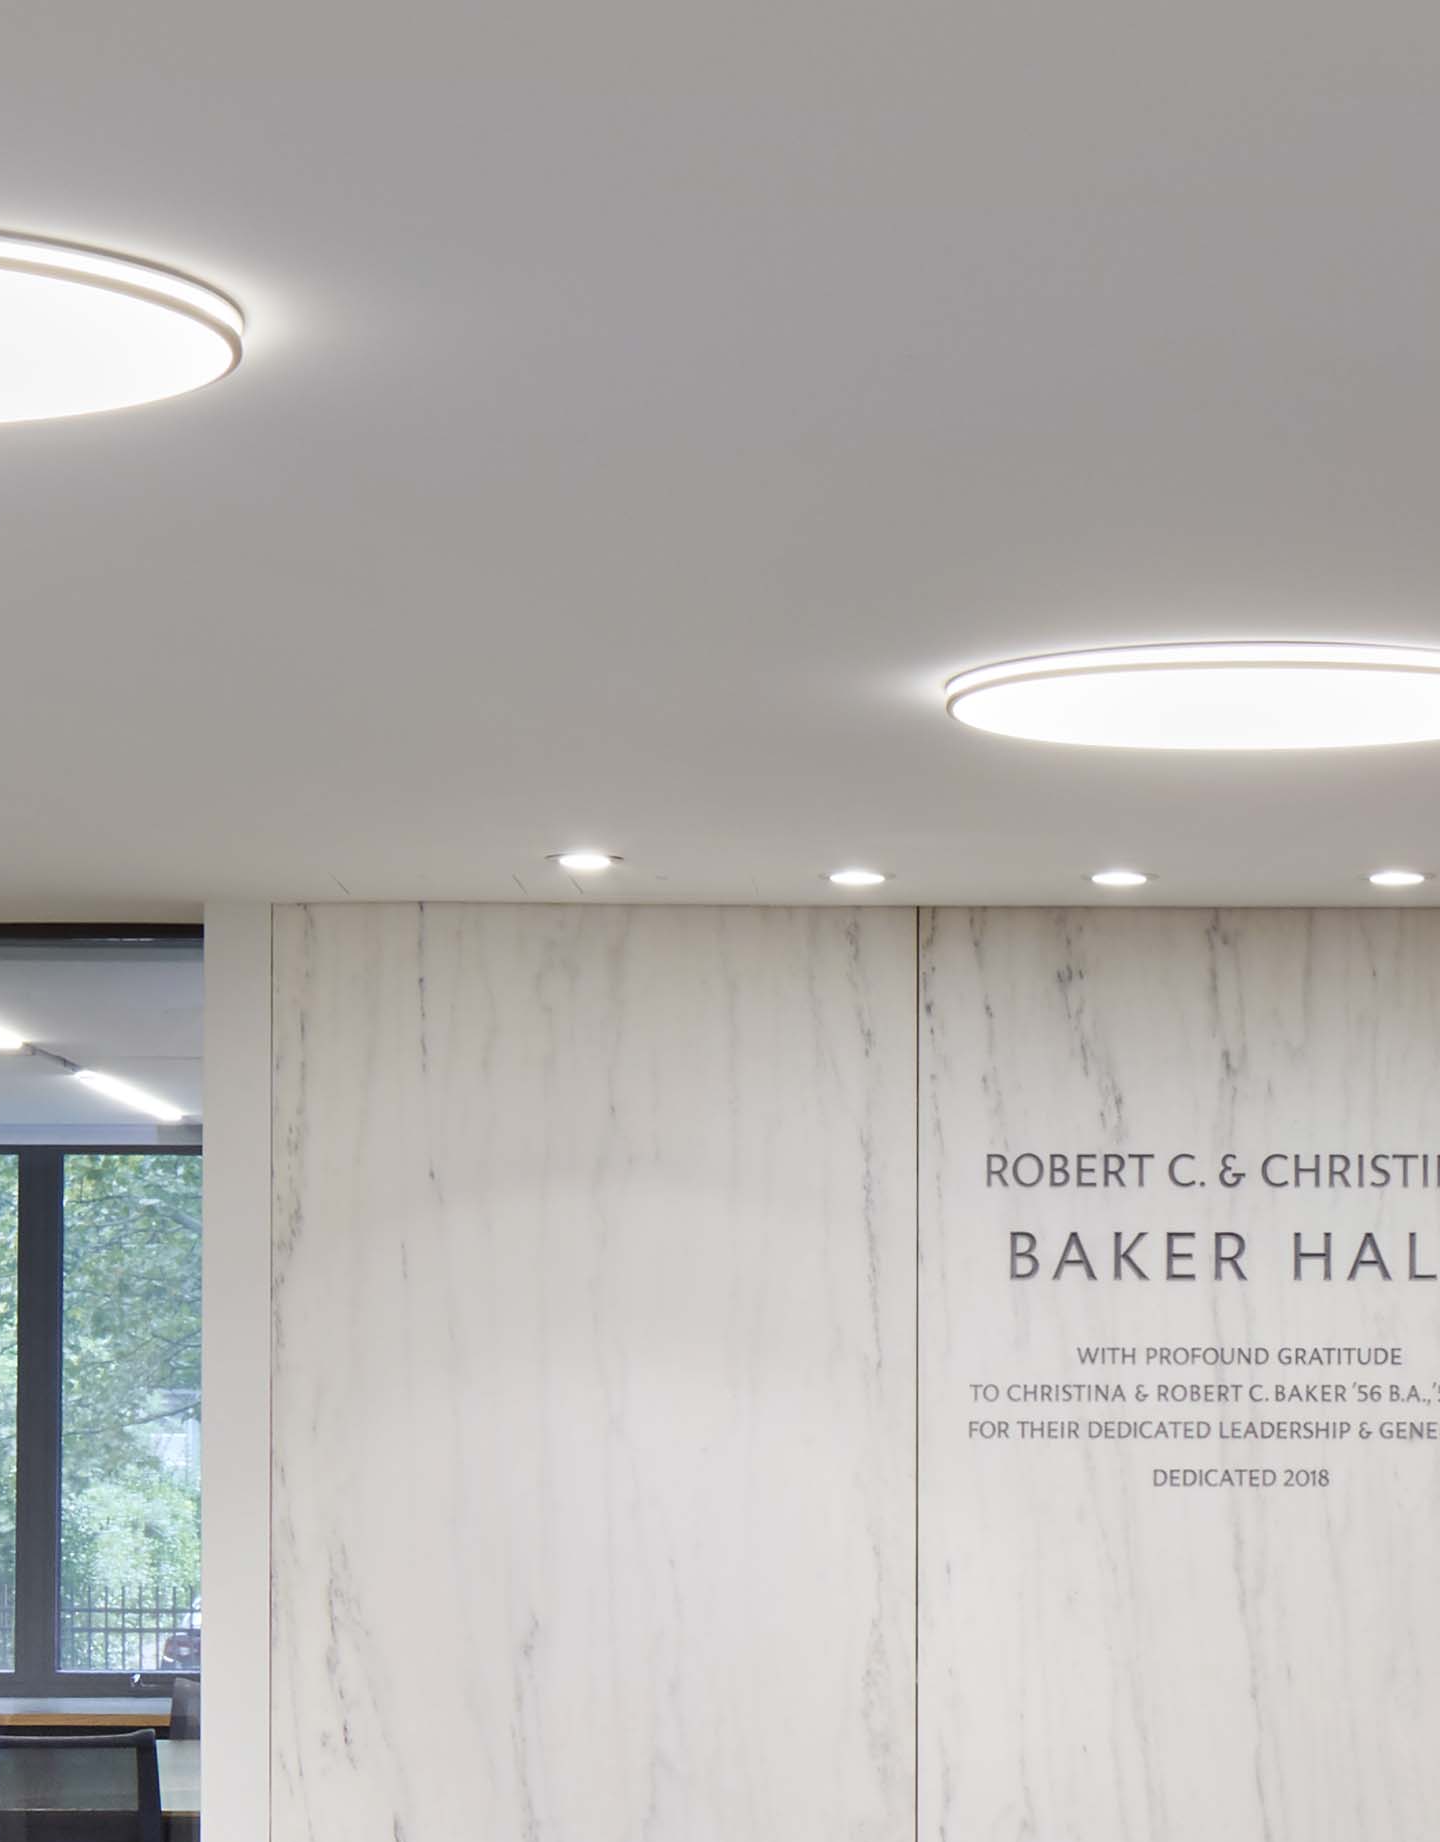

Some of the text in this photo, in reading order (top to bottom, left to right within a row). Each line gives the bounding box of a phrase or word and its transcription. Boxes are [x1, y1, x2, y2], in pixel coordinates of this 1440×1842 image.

[985, 1152, 1155, 1189] ROBERT
[1167, 1152, 1207, 1189] C.
[1218, 1152, 1247, 1190] &
[1009, 1230, 1249, 1282] BAKER
[1076, 1346, 1403, 1367] WITH PROFOUND GRATITUDE
[968, 1383, 1000, 1403] TO
[1005, 1383, 1126, 1403] CHRISTINA
[1134, 1383, 1150, 1403] &
[1156, 1383, 1244, 1403] ROBERT
[1248, 1383, 1270, 1403] C.
[1274, 1383, 1348, 1403] BAKER
[968, 1420, 1011, 1440] FOR
[1015, 1420, 1080, 1440] THEIR
[1087, 1420, 1212, 1440] DEDICATED
[1218, 1420, 1352, 1440] LEADERSHIP
[1357, 1420, 1374, 1440] &
[1152, 1468, 1331, 1488] DEDICATED 2018
